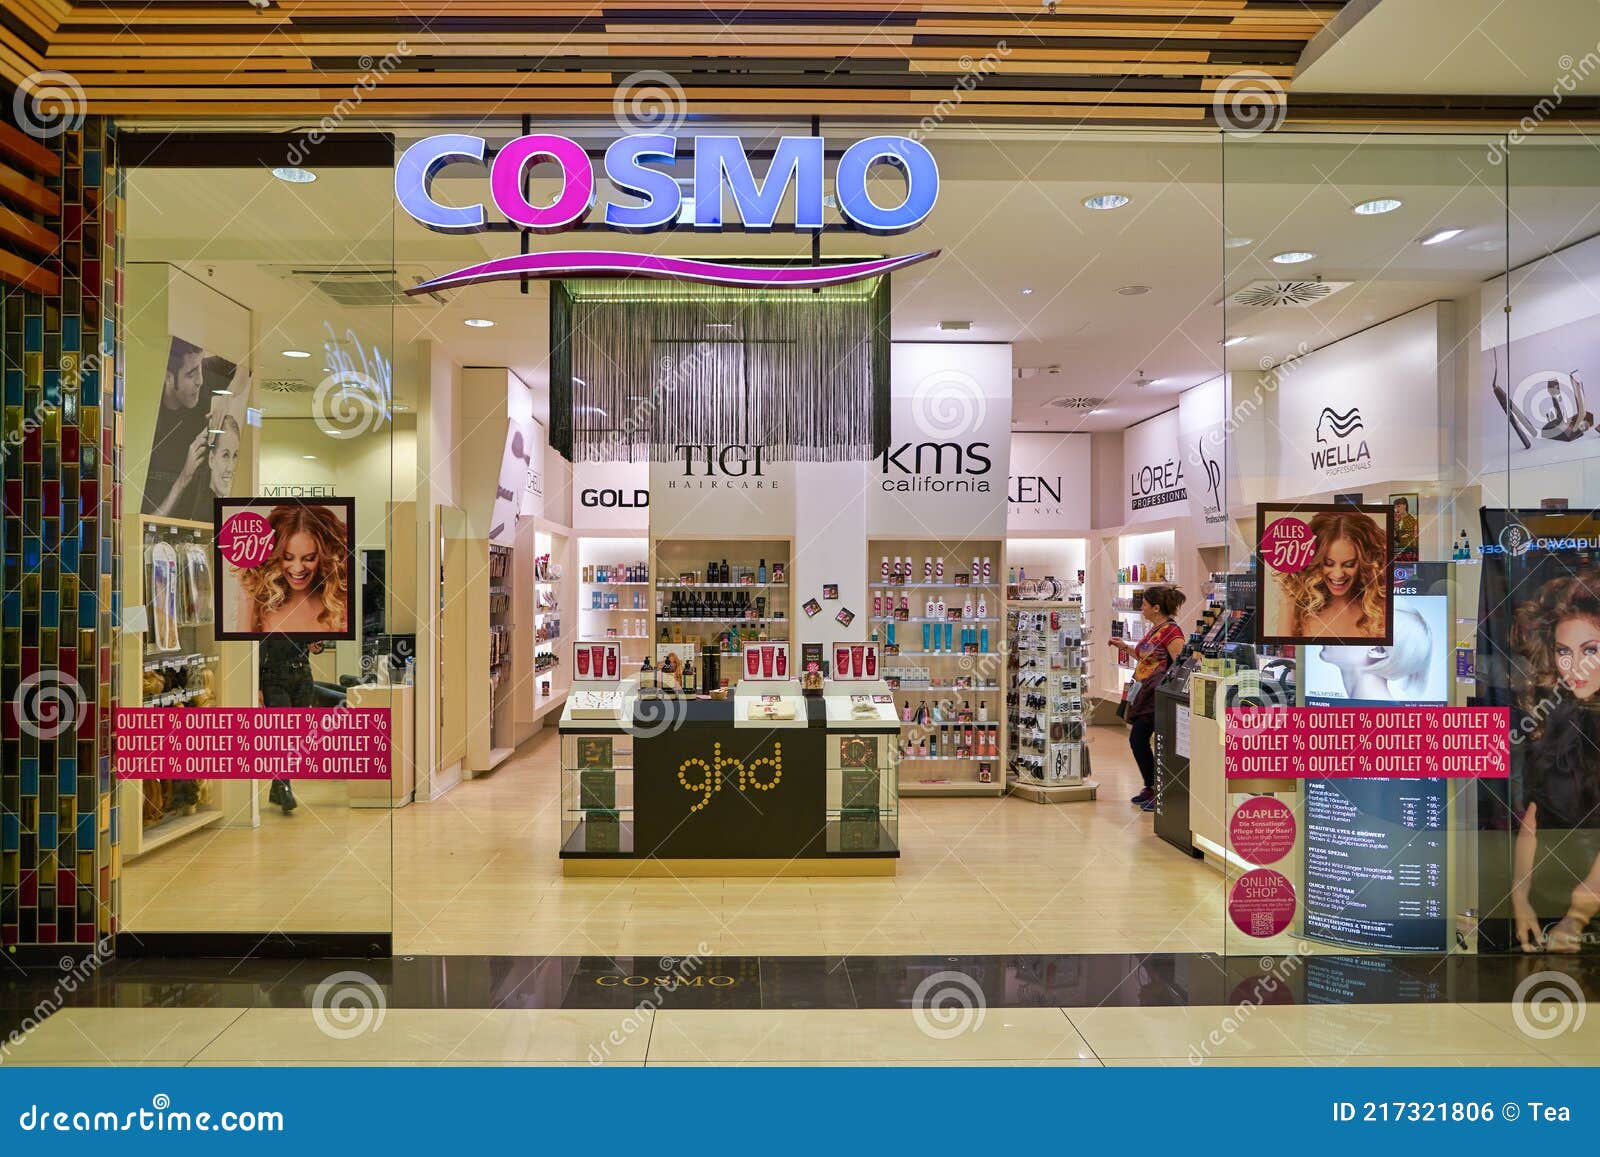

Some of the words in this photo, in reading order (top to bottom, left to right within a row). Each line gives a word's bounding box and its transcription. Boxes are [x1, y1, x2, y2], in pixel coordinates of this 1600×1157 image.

[394, 133, 939, 233] COSMO
[675, 444, 765, 476] TIGI
[1311, 440, 1371, 470] WELLA
[669, 480, 779, 489] HAIRCARE
[882, 476, 991, 492] california
[581, 488, 649, 507] GOLD
[231, 519, 263, 534] ALLES
[1273, 525, 1305, 539] ALLES
[217, 529, 276, 562] -50%
[1260, 535, 1318, 567] -50%
[117, 713, 165, 729] OUTLET
[169, 713, 182, 729] %
[185, 713, 233, 729] OUTLET
[237, 713, 250, 729] %
[254, 713, 302, 729] OUTLET
[305, 713, 318, 729] %
[322, 713, 370, 729] OUTLET
[374, 713, 387, 729] %
[1225, 713, 1238, 729] %
[1242, 713, 1288, 729] OUTLET
[1292, 713, 1305, 729] %
[1309, 713, 1356, 729] OUTLET
[1359, 713, 1371, 729] %
[1375, 713, 1422, 729] OUTLET
[1426, 713, 1439, 729] %
[1442, 713, 1489, 729] OUTLET
[1492, 713, 1505, 729] %
[117, 735, 165, 751] OUTLET
[169, 735, 182, 751] %
[185, 735, 233, 751] OUTLET
[237, 735, 250, 751] %
[254, 735, 302, 751] OUTLET
[305, 735, 318, 751] %
[322, 735, 370, 751] OUTLET
[374, 735, 387, 751] %
[1225, 734, 1238, 750] %
[1242, 734, 1288, 750] OUTLET
[1292, 734, 1305, 750] %
[1309, 734, 1356, 750] OUTLET
[1359, 734, 1371, 750] %
[1375, 734, 1422, 750] OUTLET
[1426, 734, 1439, 750] %
[1442, 734, 1489, 750] OUTLET
[1492, 734, 1505, 750] %
[117, 757, 165, 773] OUTLET
[169, 757, 182, 773] %
[185, 757, 233, 773] OUTLET
[237, 757, 250, 773] %
[254, 757, 302, 773] OUTLET
[305, 757, 318, 773] %
[322, 757, 370, 773] OUTLET
[374, 757, 387, 773] %
[1225, 756, 1238, 772] %
[1242, 756, 1288, 772] OUTLET
[1292, 756, 1305, 772] %
[1309, 756, 1356, 772] OUTLET
[1359, 756, 1371, 772] %
[1375, 756, 1422, 772] OUTLET
[1426, 756, 1439, 772] %
[1442, 756, 1489, 772] OUTLET
[1492, 756, 1505, 772] %
[678, 742, 782, 812] ghd
[1237, 809, 1289, 819] OLAPLEX
[1240, 877, 1284, 887] ONLINE
[1246, 888, 1278, 898] SHOP
[595, 975, 735, 986] COSMO
